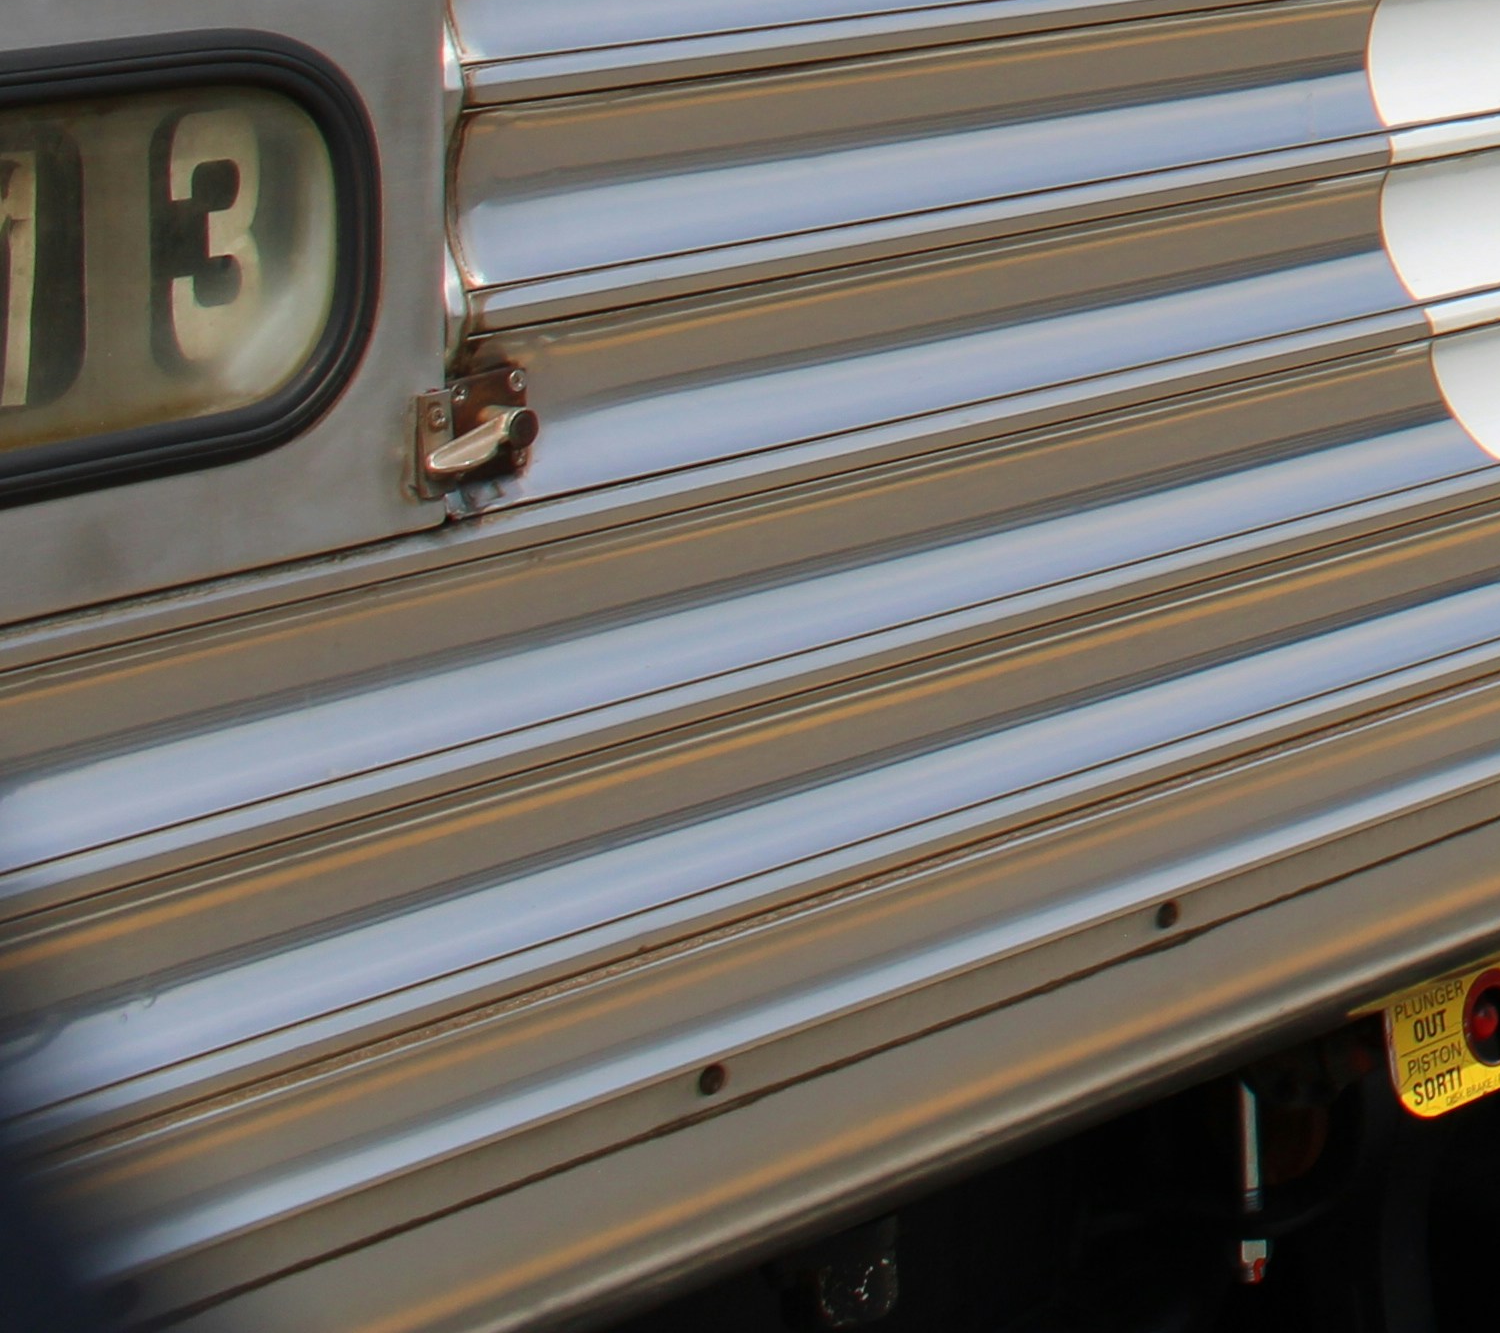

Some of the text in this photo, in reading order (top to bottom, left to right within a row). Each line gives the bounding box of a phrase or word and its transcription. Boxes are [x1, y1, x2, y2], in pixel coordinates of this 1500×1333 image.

[1395, 980, 1465, 1023] PLUNGER
[1413, 1009, 1447, 1043] OUT
[1407, 1040, 1462, 1076] PISTON
[1413, 1066, 1463, 1106] SORTI
[1466, 1078, 1493, 1097] BRAKE
